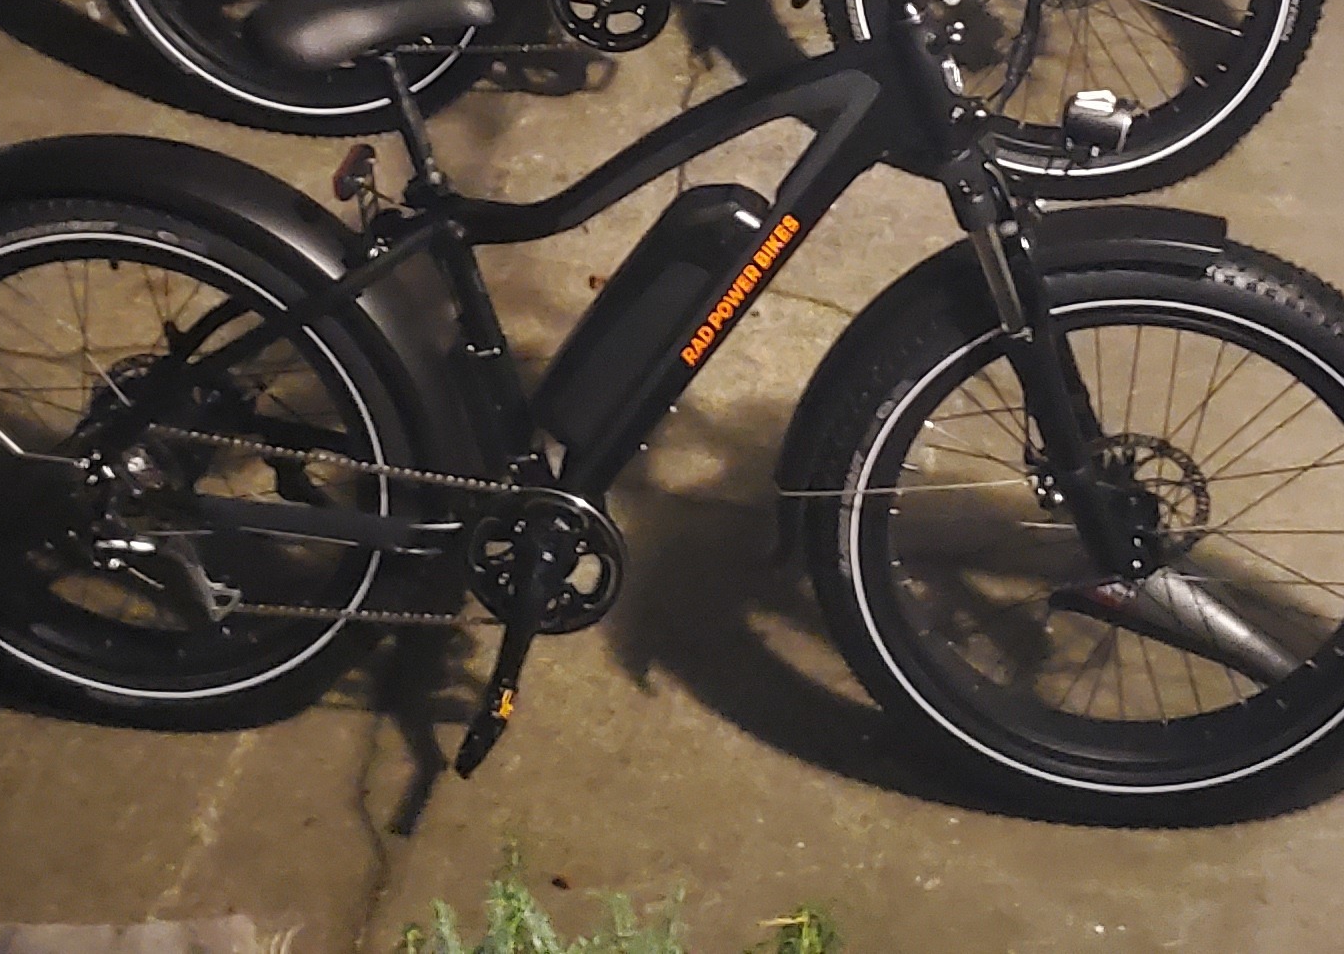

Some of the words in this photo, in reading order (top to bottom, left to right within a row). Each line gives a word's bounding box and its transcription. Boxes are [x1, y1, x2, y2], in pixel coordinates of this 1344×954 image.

[680, 325, 716, 367] RAD
[707, 264, 763, 331] POWER
[753, 214, 800, 270] BIKES
